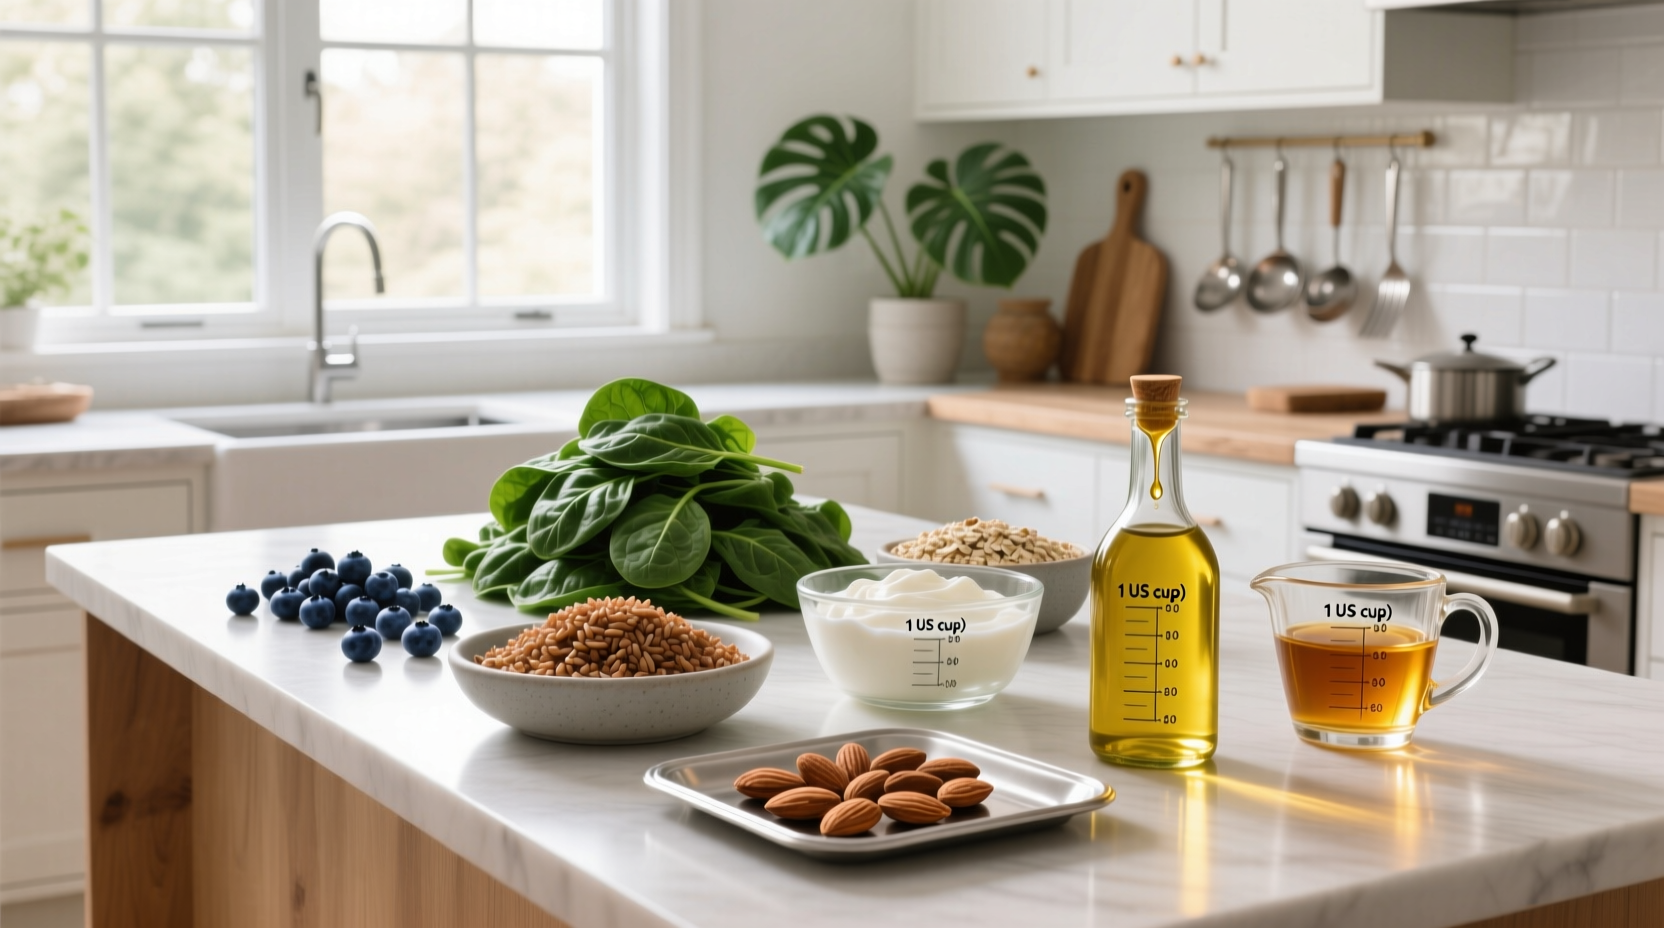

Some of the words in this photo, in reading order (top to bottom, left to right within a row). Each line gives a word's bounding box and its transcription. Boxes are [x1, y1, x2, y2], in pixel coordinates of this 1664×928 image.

[1118, 583, 1124, 598] 1
[1129, 583, 1150, 598] US
[1153, 583, 1186, 603] cup)
[1324, 603, 1331, 617] 1
[1336, 603, 1356, 617] US
[1360, 603, 1392, 622] cup)
[905, 618, 912, 632] 1
[916, 618, 934, 631] US
[937, 617, 966, 635] cup)
